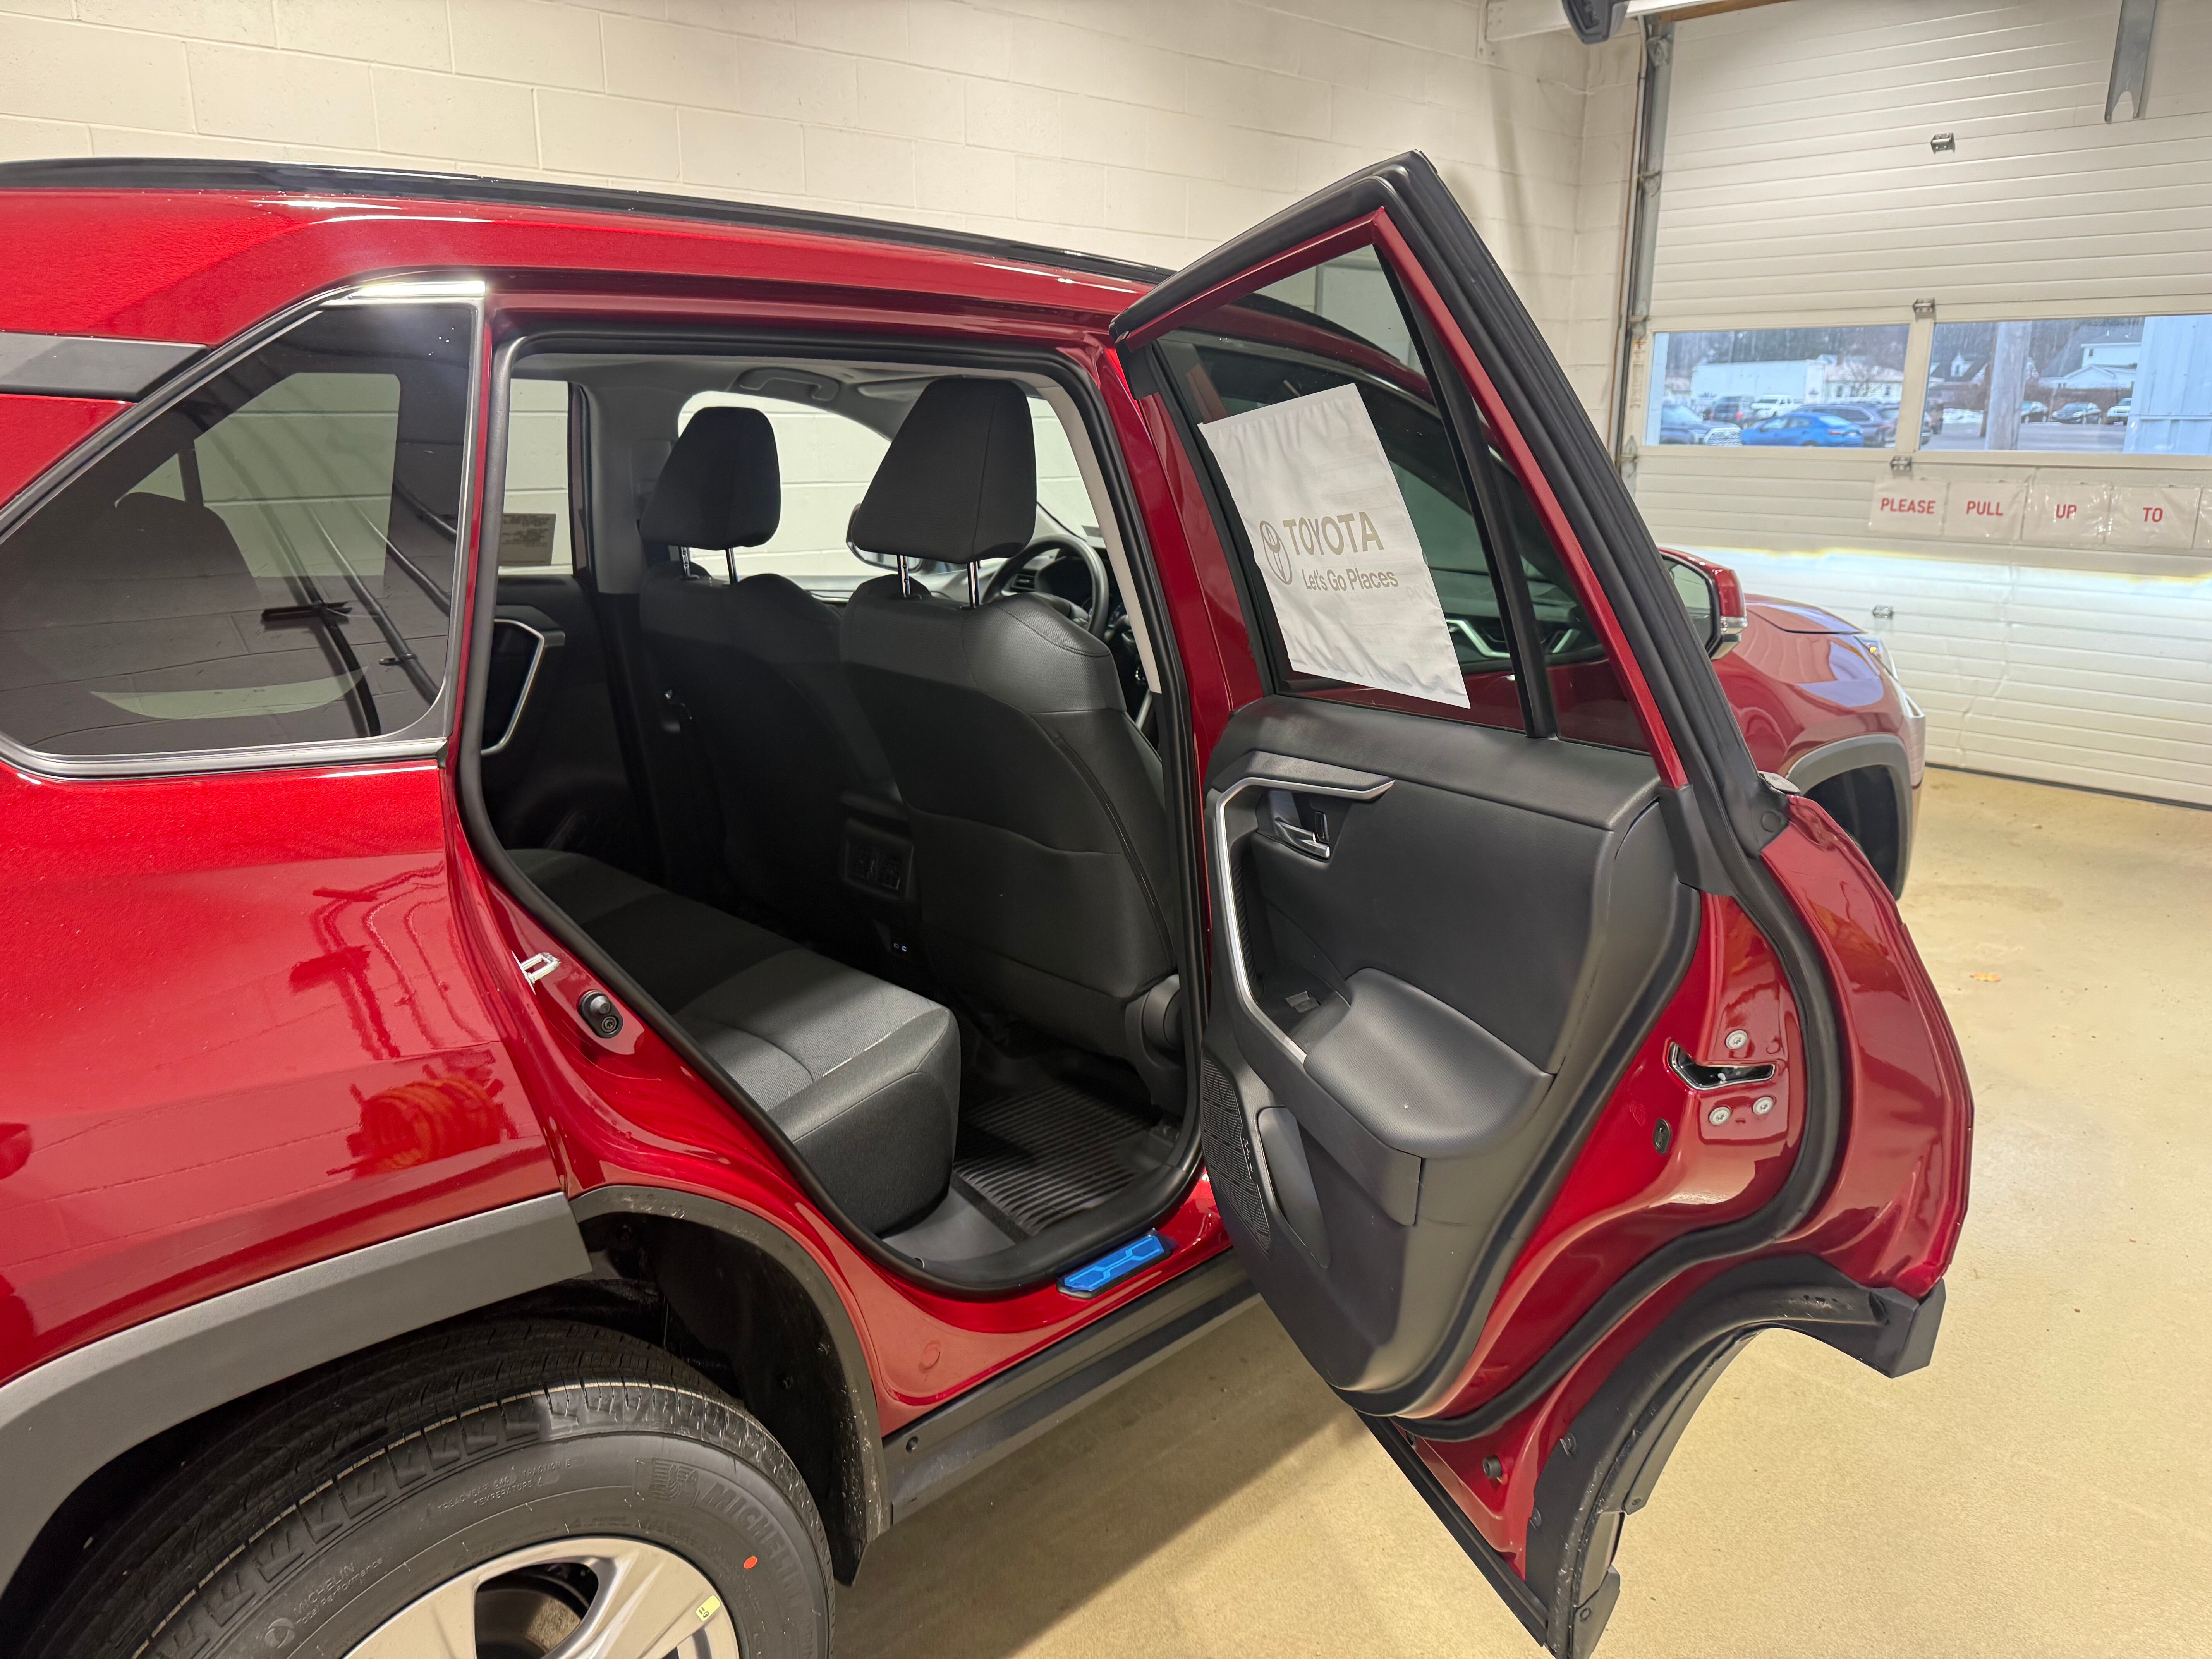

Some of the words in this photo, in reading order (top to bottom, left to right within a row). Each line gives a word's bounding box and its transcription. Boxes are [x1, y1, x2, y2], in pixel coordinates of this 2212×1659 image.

[1880, 497, 1936, 515] PLEASE
[1966, 501, 2004, 516] PULL
[2056, 504, 2077, 519] UP
[2143, 507, 2163, 522] TO
[1283, 511, 1384, 555] TOYOTA
[1302, 568, 1328, 591] Let's
[1326, 569, 1347, 591] Go
[1345, 568, 1399, 590] Places
[700, 1482, 805, 1600] MICHELIN
[293, 1561, 355, 1616] MICHELIN
